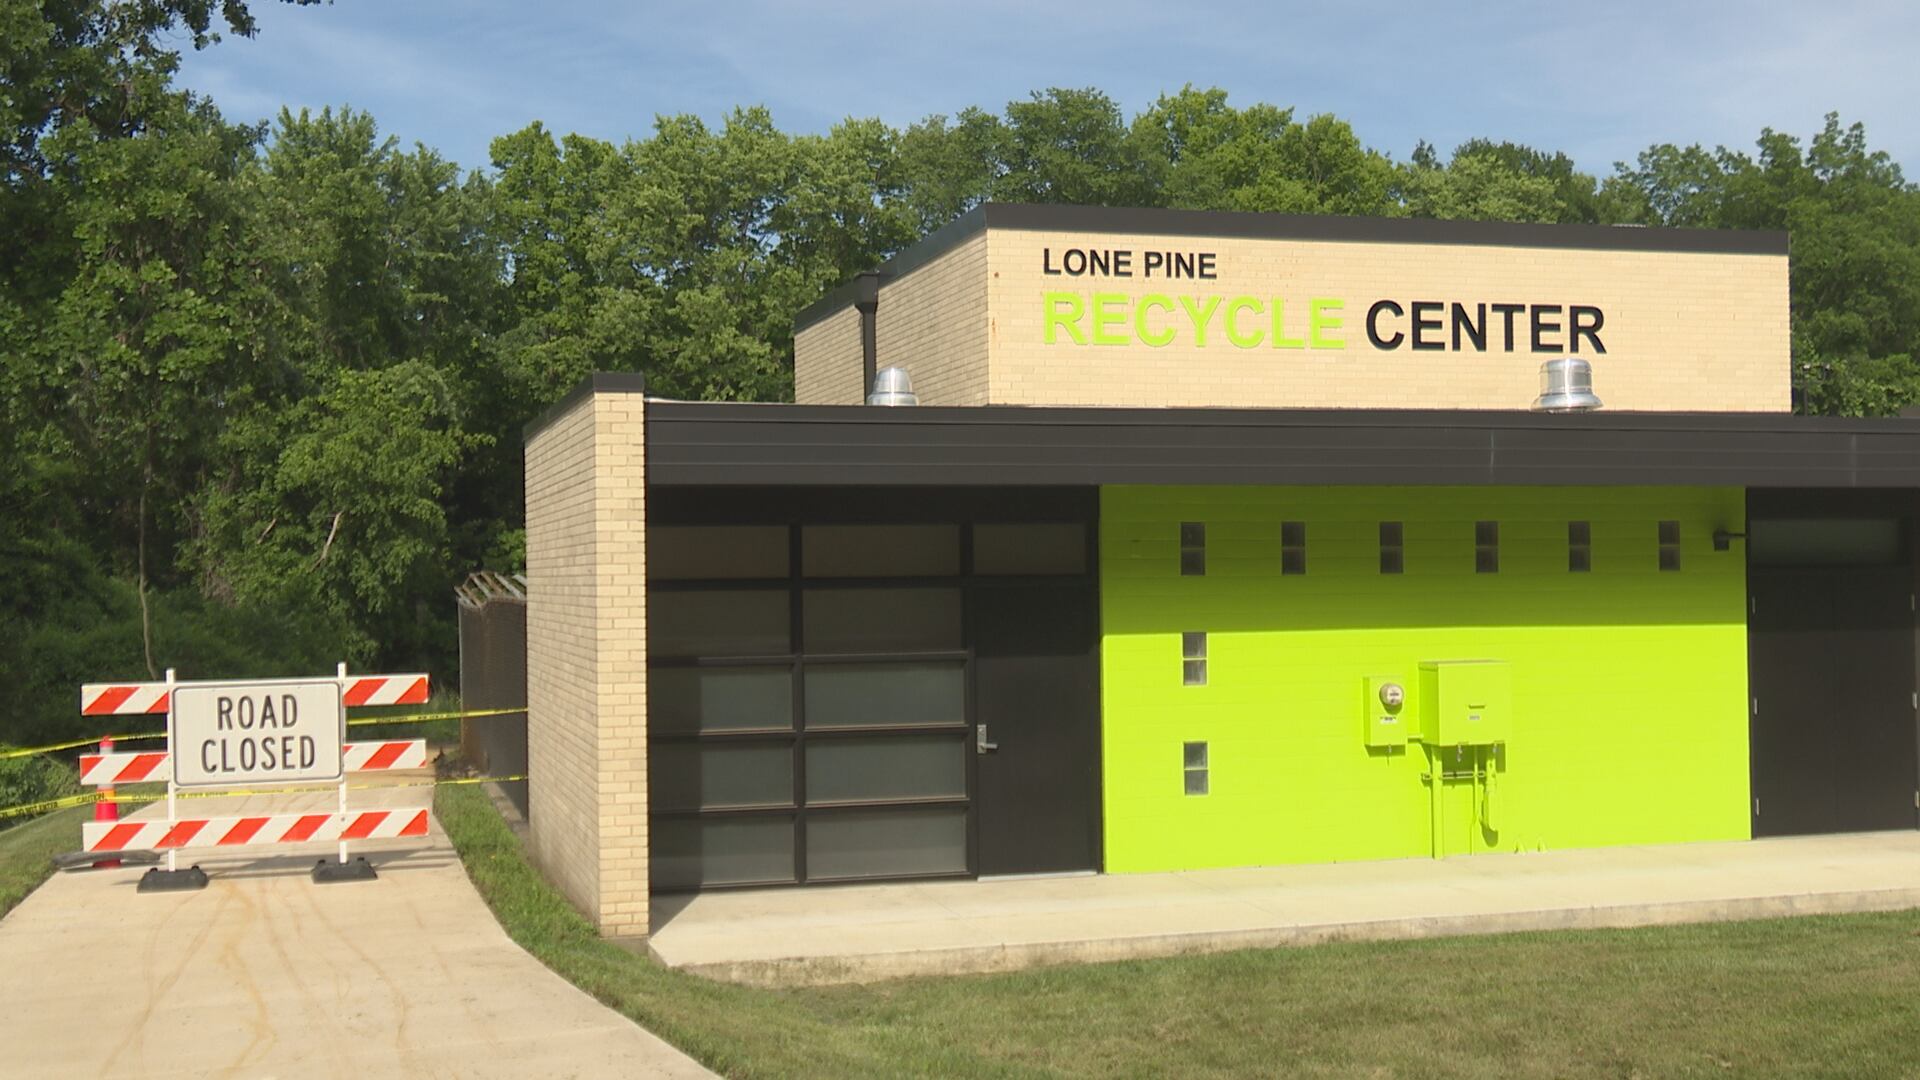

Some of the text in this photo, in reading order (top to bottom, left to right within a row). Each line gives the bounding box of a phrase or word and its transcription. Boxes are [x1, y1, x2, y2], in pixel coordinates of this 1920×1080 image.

[1043, 248, 1217, 279] LONE PINE
[1043, 291, 1607, 354] RECYCLE CENTER
[217, 694, 298, 730] ROAD
[201, 736, 315, 773] CLOSED
